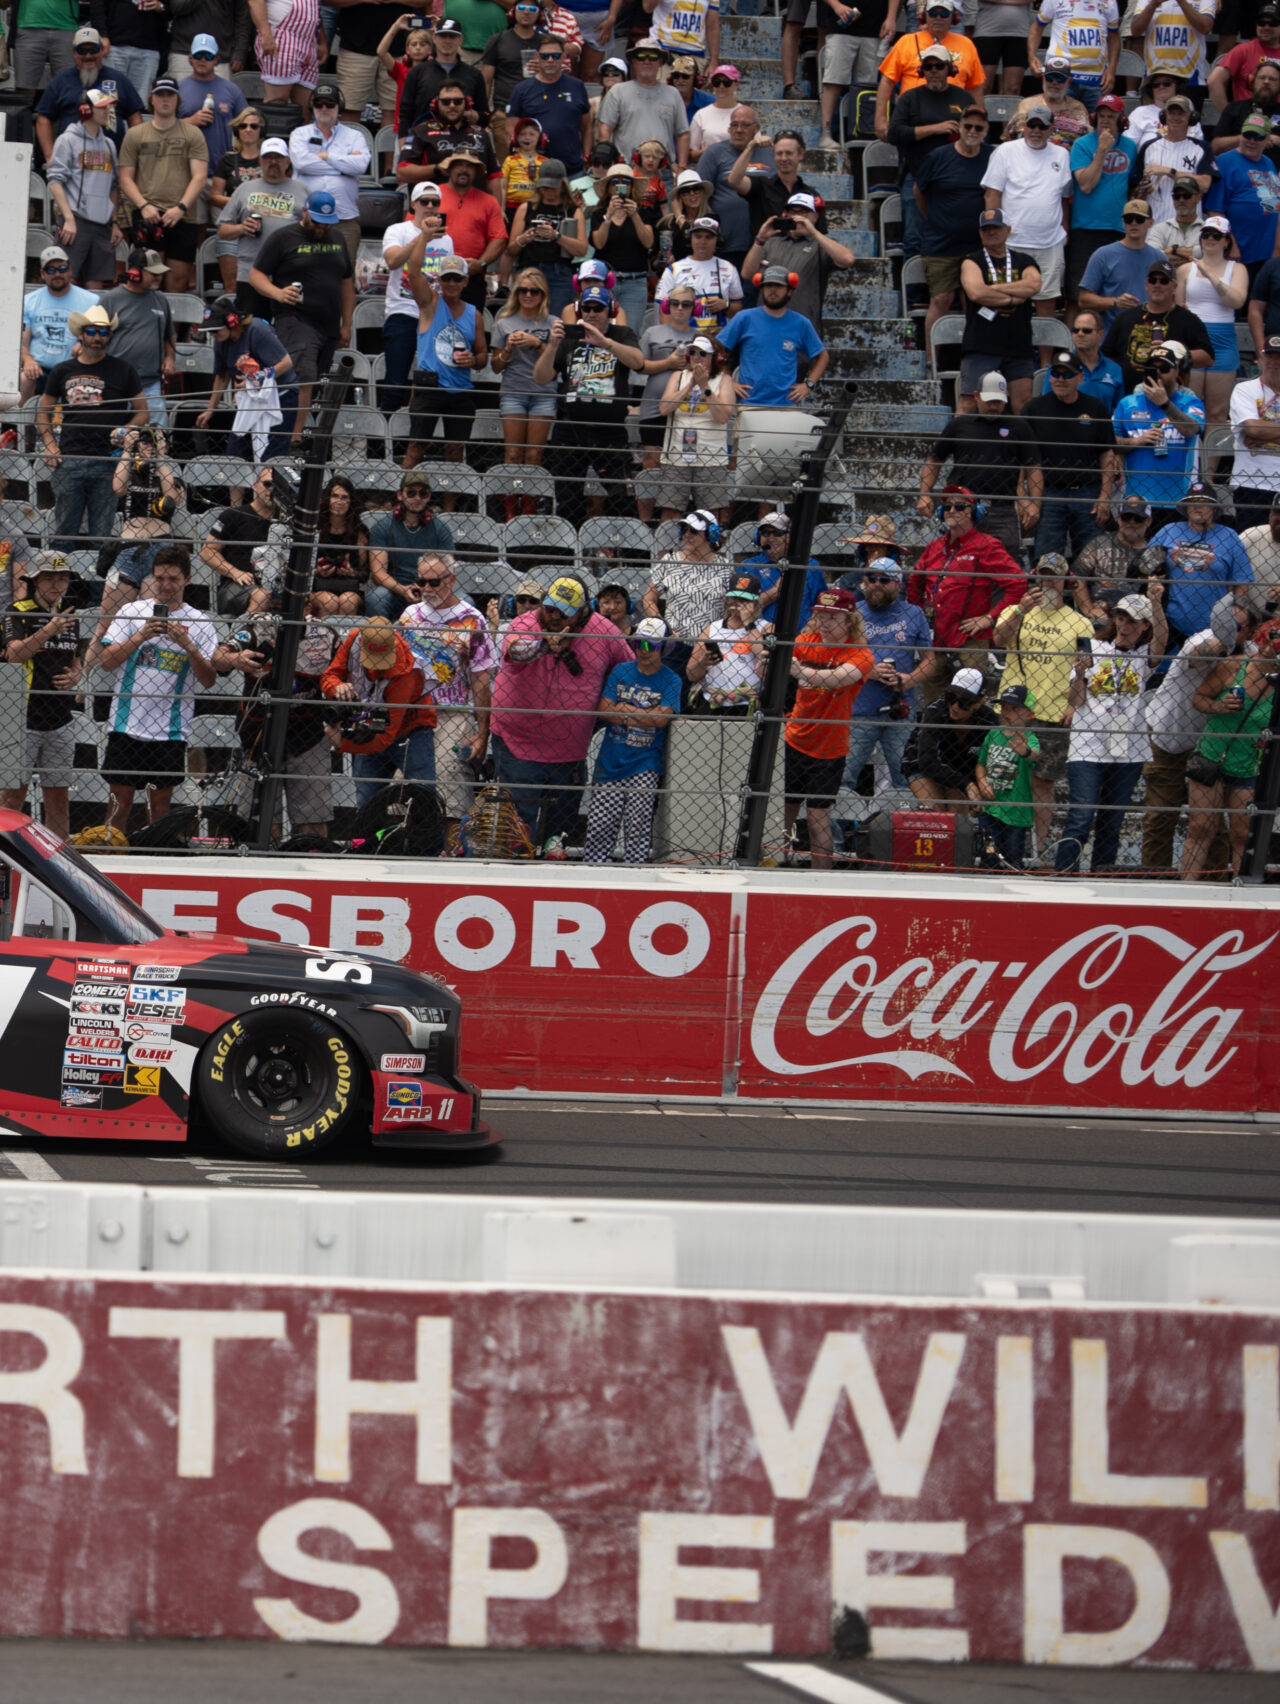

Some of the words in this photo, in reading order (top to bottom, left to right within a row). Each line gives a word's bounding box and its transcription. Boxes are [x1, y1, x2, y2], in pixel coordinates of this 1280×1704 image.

[671, 11, 702, 33] NAPA
[1069, 28, 1101, 46] NAPA
[1155, 27, 1188, 46] NAPA
[248, 195, 293, 211] BLANEY
[914, 839, 933, 856] 13
[77, 963, 128, 975] CRAFTSMAN
[74, 984, 128, 997] COMETIC
[132, 987, 184, 1002] SKF
[250, 991, 337, 1018] GOODYEAR
[751, 915, 1280, 1088] Coca-Cola
[127, 1003, 185, 1019] JESEL
[72, 1018, 112, 1028] LINCOLN
[80, 1028, 115, 1036] WELDERS
[66, 1035, 122, 1049] CALICO
[210, 1020, 245, 1082] EAGLE
[67, 1053, 121, 1067] tilton
[384, 1056, 423, 1069] SIMPSON
[63, 1067, 100, 1085] Holley
[286, 1037, 352, 1148] GOODYEAR
[390, 1091, 422, 1099] SUNOCO
[383, 1106, 433, 1121] ARP
[437, 1098, 454, 1120] 11
[252, 1496, 1280, 1672] SPEED
